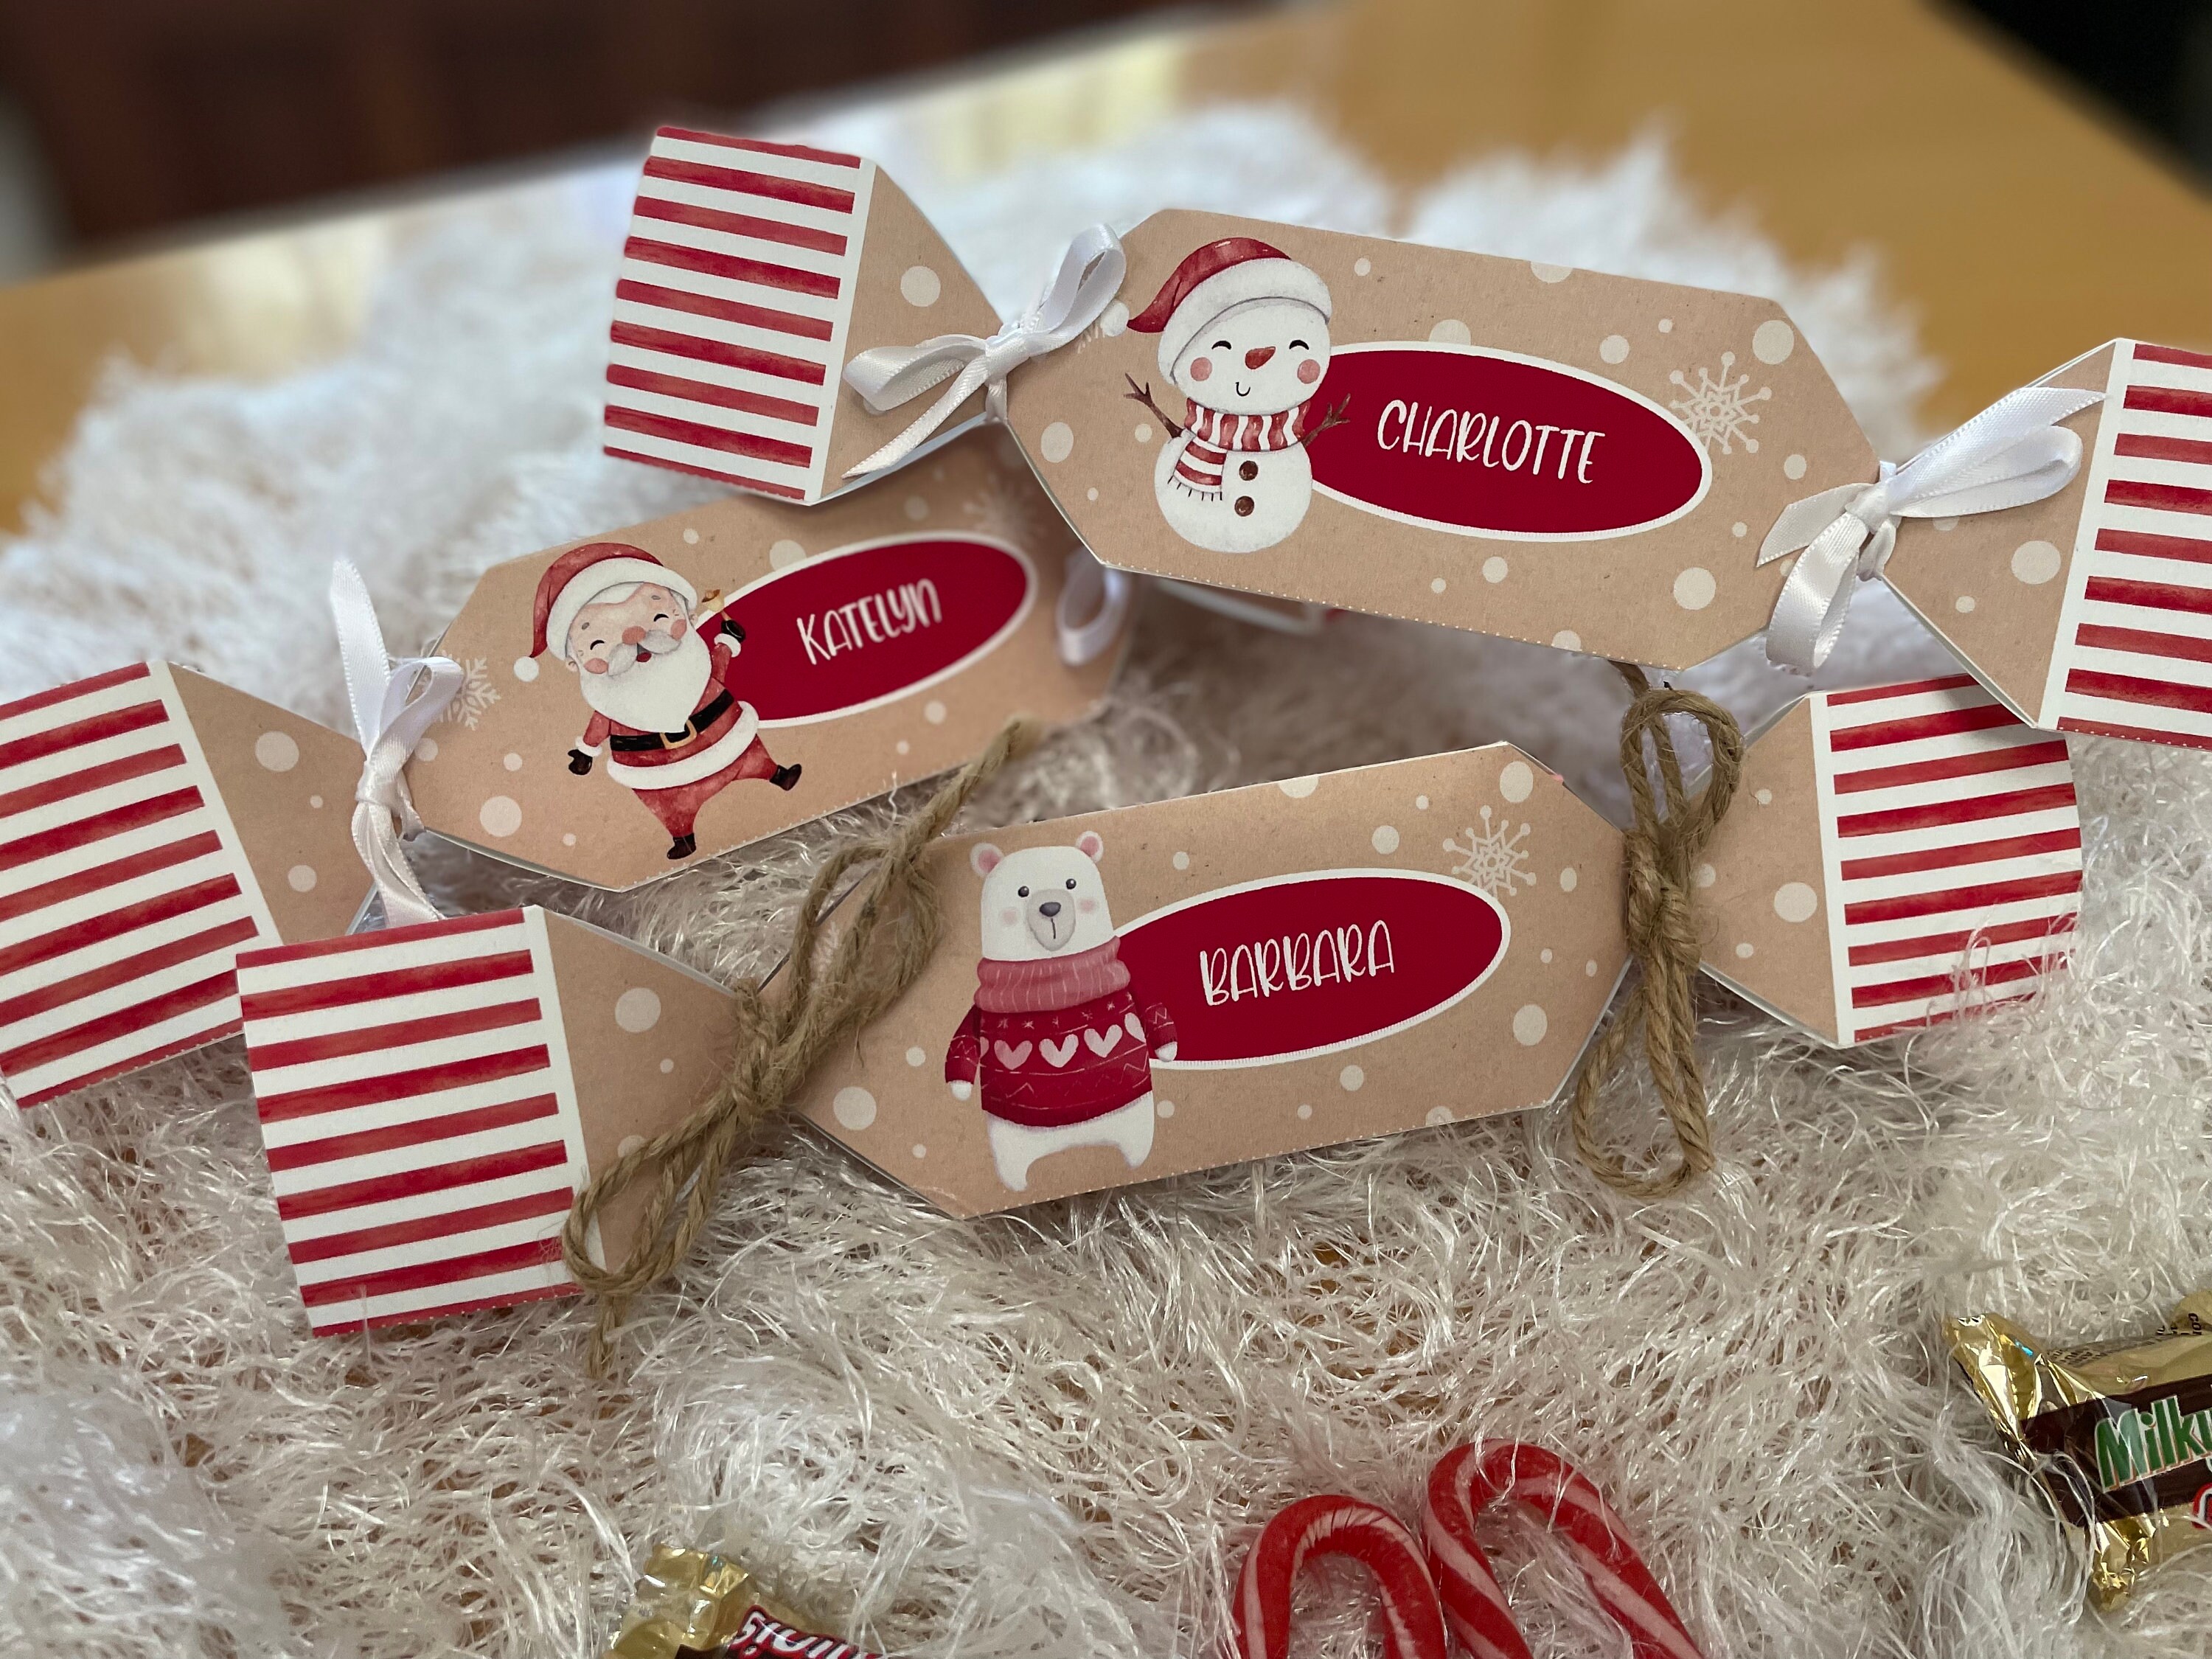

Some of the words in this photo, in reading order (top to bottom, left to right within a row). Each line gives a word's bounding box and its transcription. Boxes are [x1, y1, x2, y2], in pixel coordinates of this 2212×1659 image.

[1377, 400, 1606, 484] CHARLOTTE
[797, 578, 942, 665] KATELYN
[1200, 920, 1394, 1006] BARBARA
